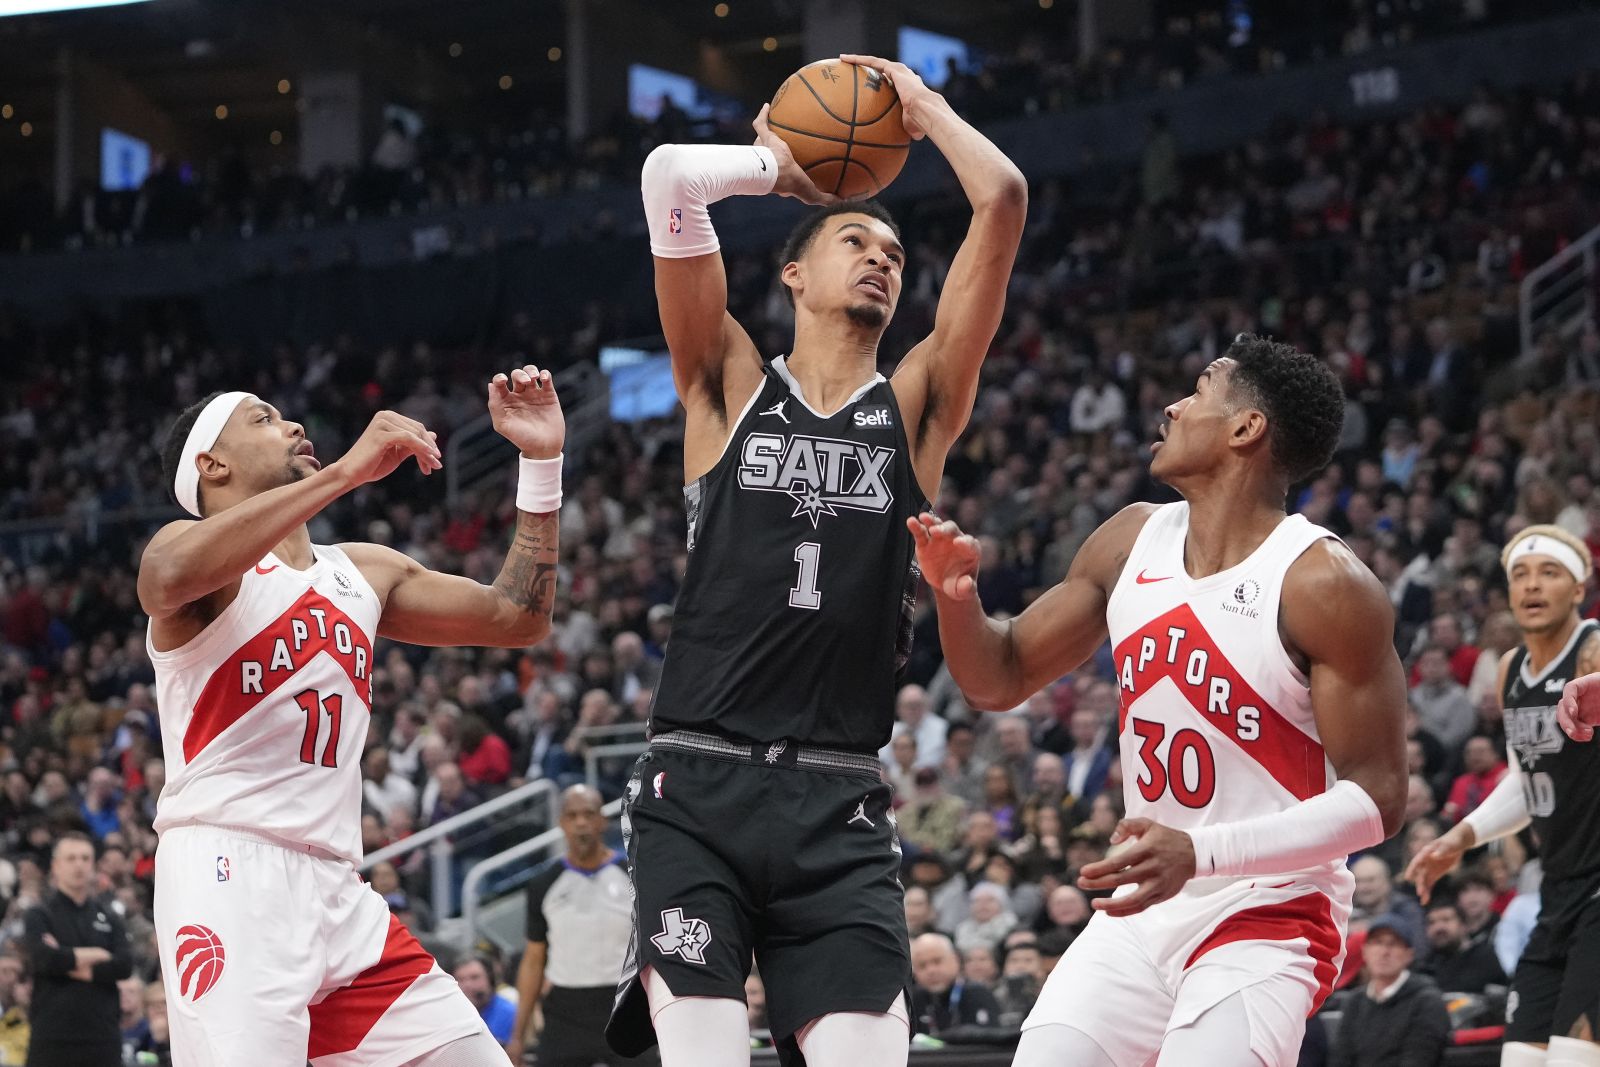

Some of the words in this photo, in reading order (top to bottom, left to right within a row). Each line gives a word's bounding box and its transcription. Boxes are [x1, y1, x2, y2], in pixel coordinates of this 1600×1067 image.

[853, 410, 892, 427] Self.
[738, 433, 896, 514] SATX
[336, 588, 350, 597] Sun
[789, 542, 821, 610] 1
[1220, 602, 1239, 613] Sun
[1240, 606, 1259, 619] Life
[1116, 626, 1261, 742] APTORS
[293, 688, 343, 769] 11
[1132, 716, 1216, 809] 30
